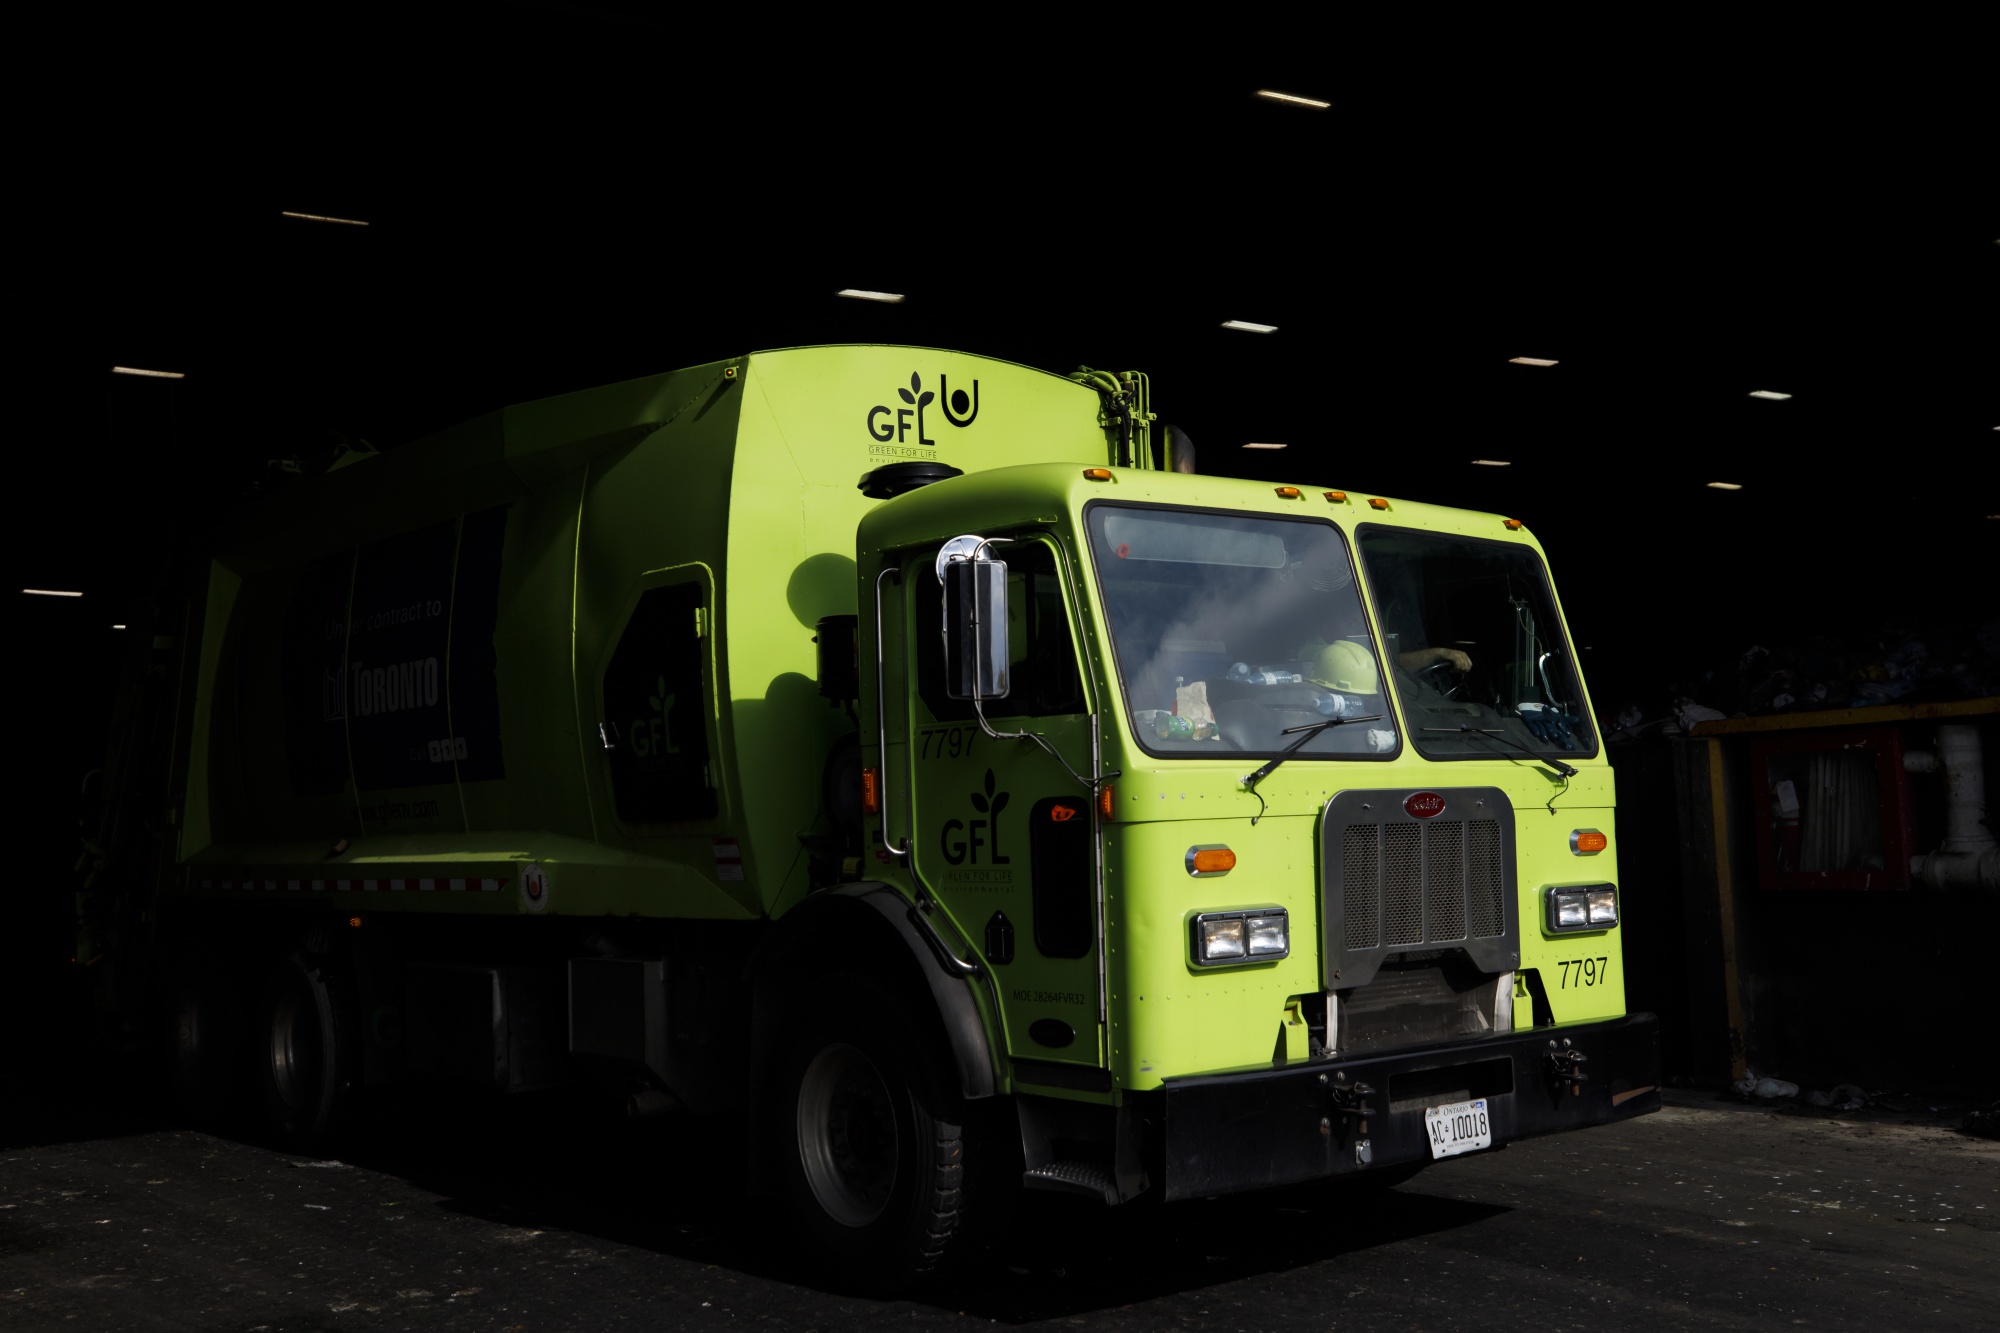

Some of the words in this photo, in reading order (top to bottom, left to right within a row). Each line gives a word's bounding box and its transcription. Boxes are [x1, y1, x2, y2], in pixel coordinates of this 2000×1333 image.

[867, 391, 935, 446] GFL
[868, 446, 897, 455] GREEN
[901, 448, 917, 457] FOR
[921, 450, 937, 459] LIFE
[325, 616, 365, 640] Uner
[367, 601, 422, 631] contract
[427, 599, 442, 618] to
[352, 656, 439, 718] TORONTO
[630, 693, 680, 758] GFL
[921, 726, 979, 760] 7797
[941, 792, 1010, 865] GFL
[973, 871, 991, 881] FOR
[994, 871, 1013, 882] LIFE
[1558, 956, 1608, 989] 7797
[1013, 989, 1032, 1002] MOE
[1451, 1112, 1488, 1142] 10018
